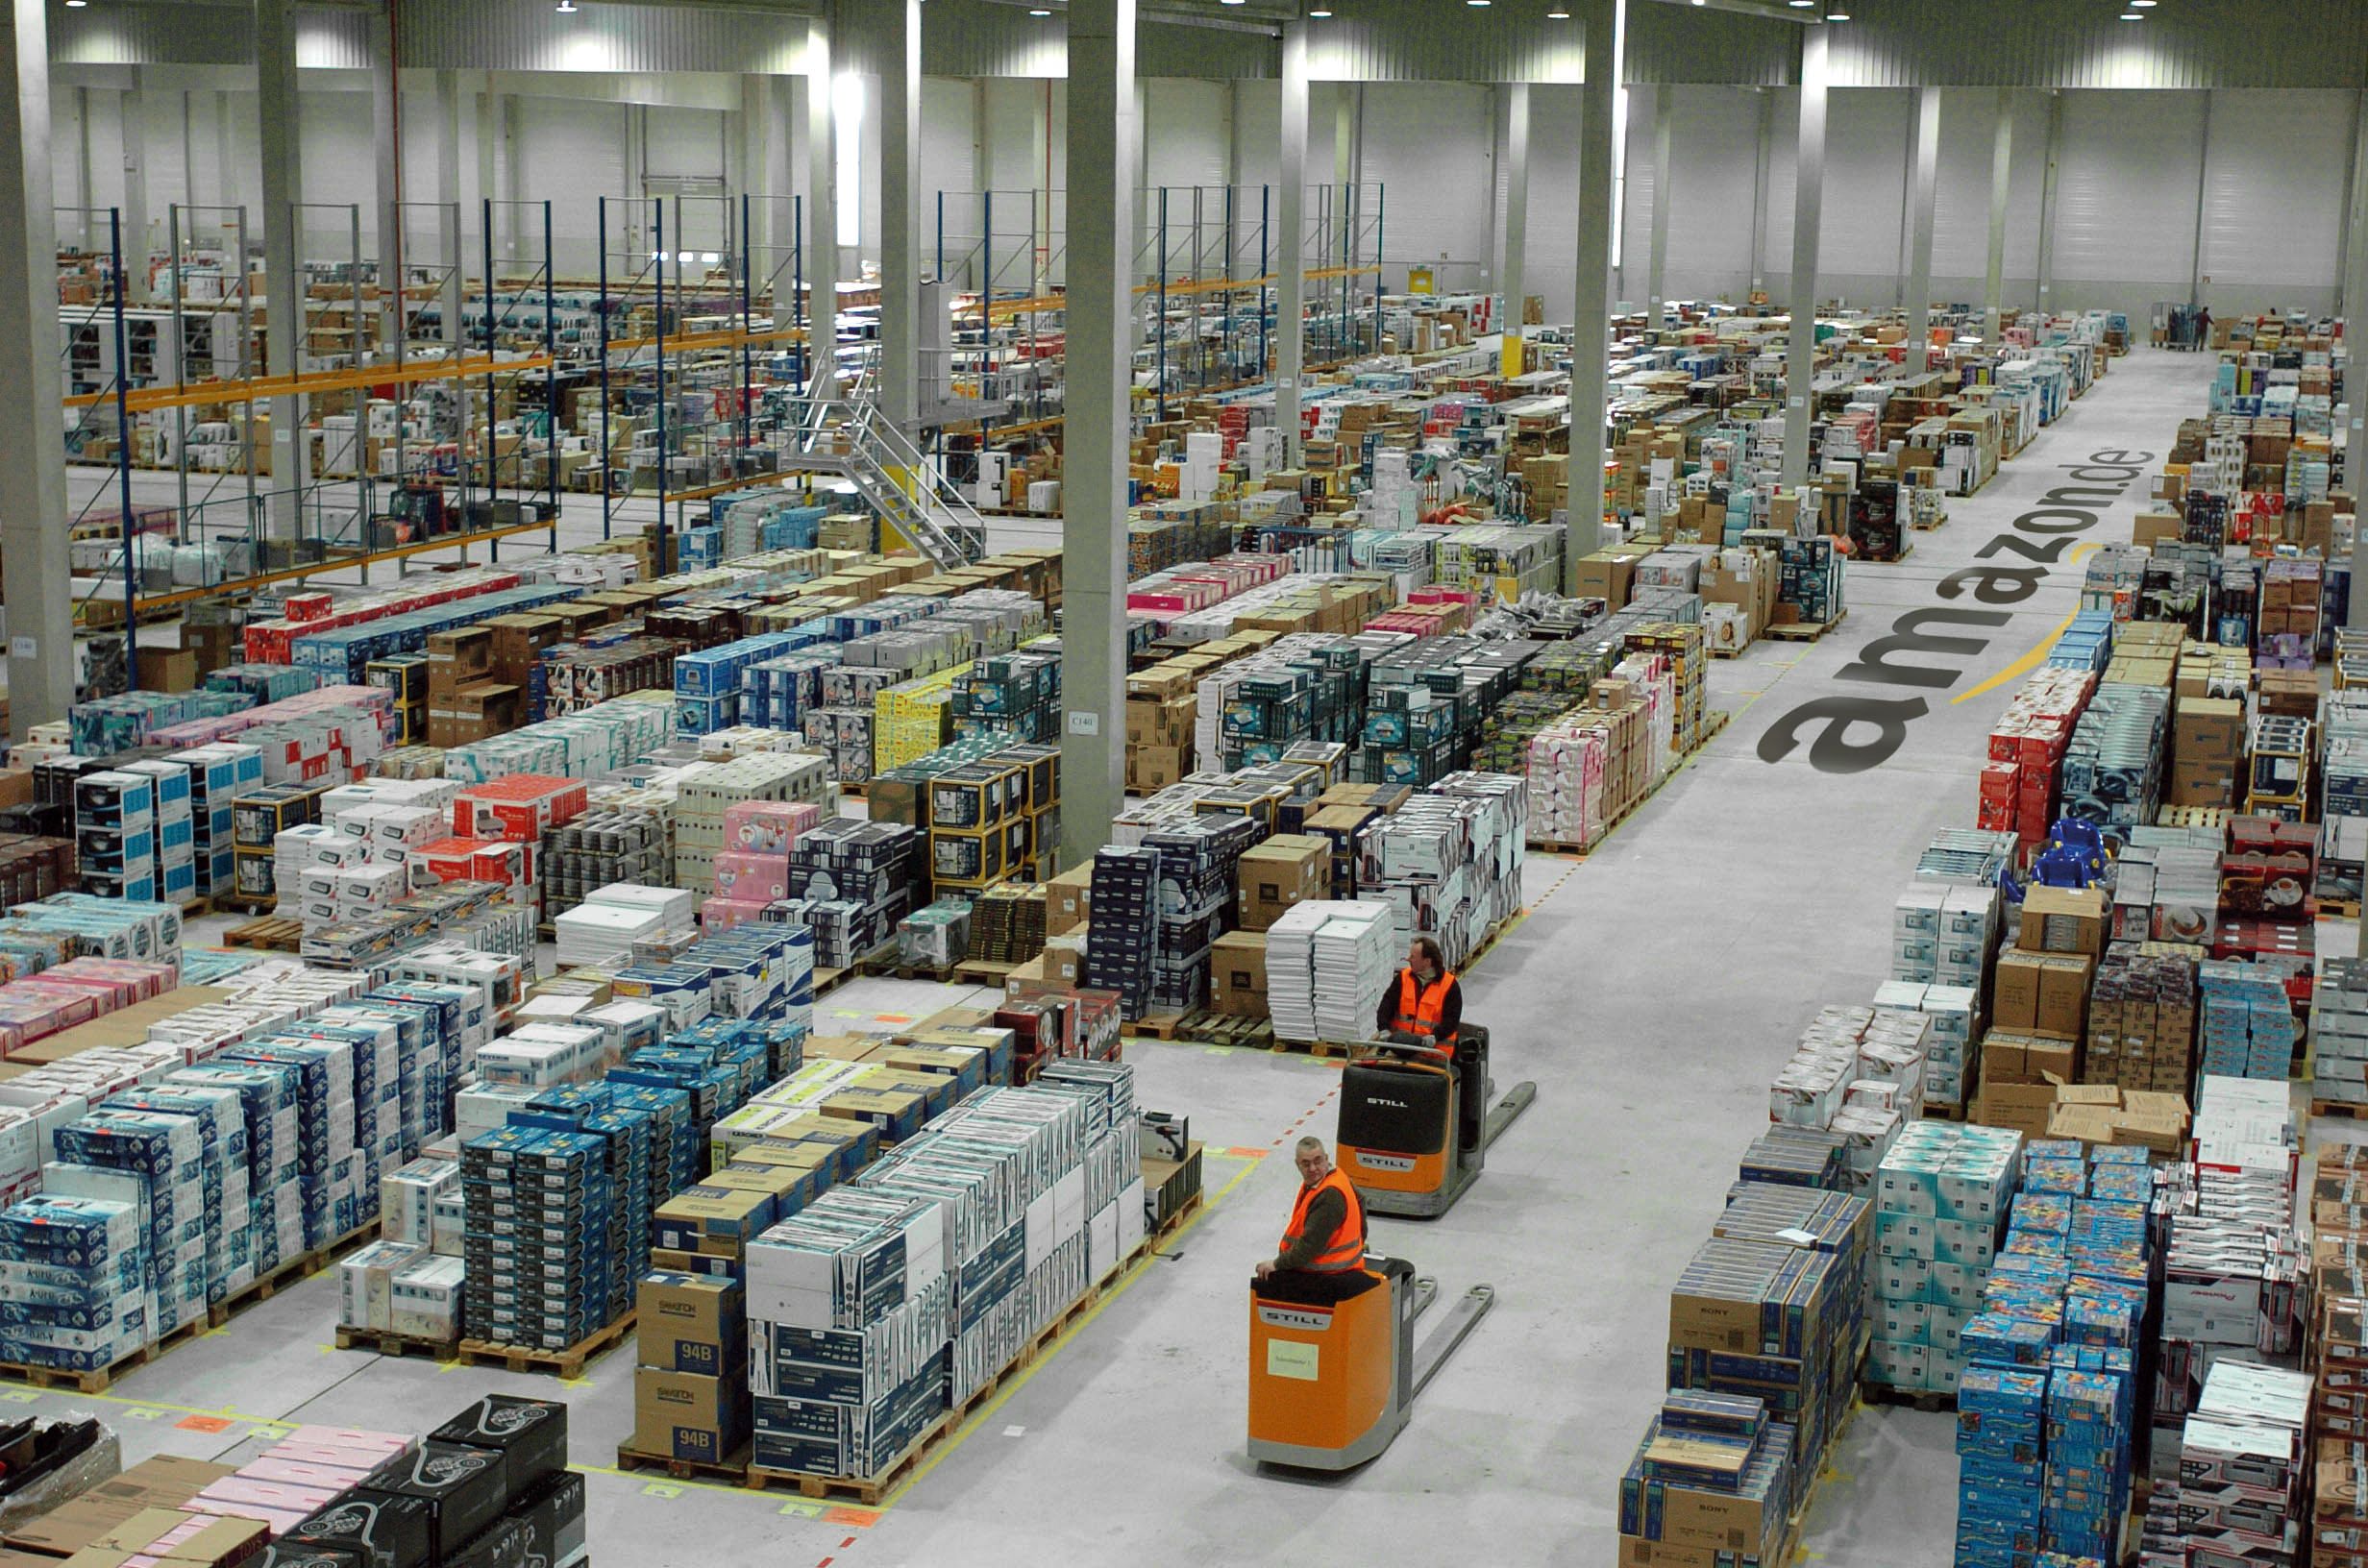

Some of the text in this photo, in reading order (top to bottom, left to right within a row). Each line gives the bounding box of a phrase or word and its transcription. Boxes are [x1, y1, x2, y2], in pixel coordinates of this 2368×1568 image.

[1756, 449, 2156, 774] amazon.de
[1367, 1097, 1409, 1108] STILL
[1361, 1156, 1410, 1169] STILL
[1265, 1311, 1324, 1326] STILL
[1700, 1307, 1730, 1316] SONY
[681, 1342, 713, 1361] 94B
[678, 1430, 710, 1448] 94B
[1698, 1503, 1731, 1515] SONY
